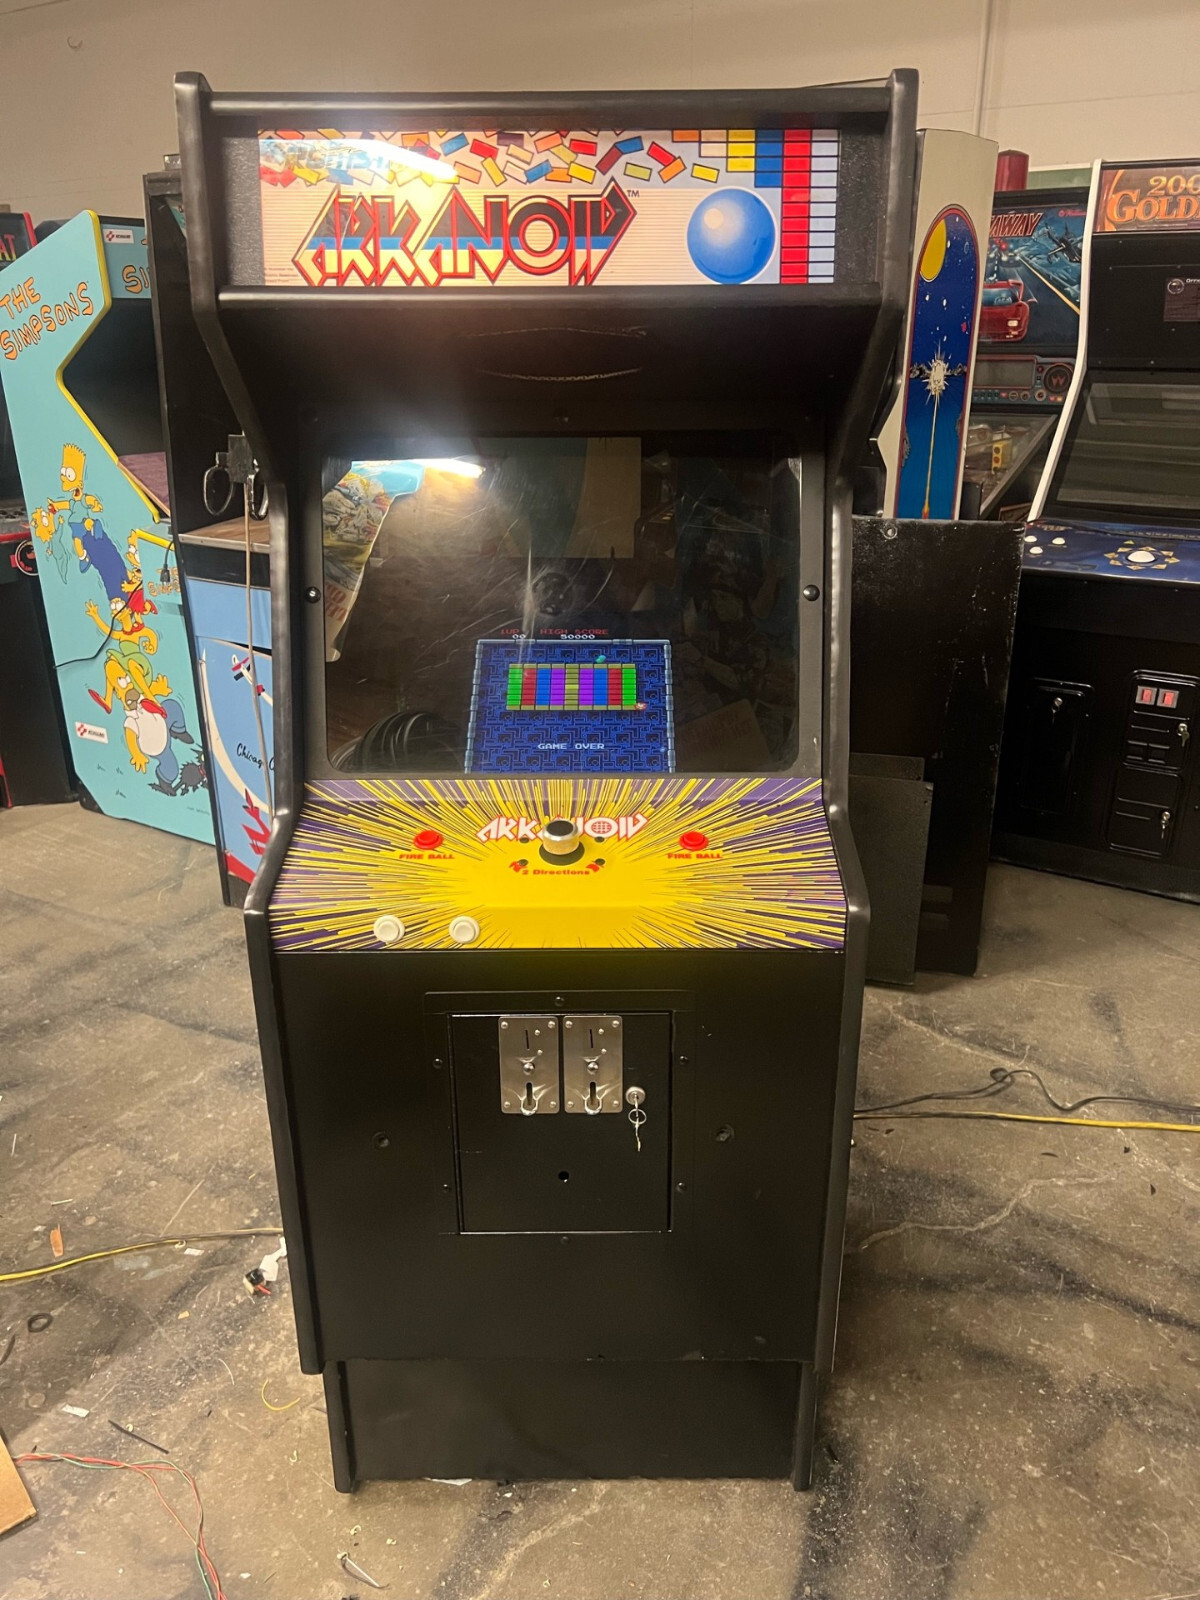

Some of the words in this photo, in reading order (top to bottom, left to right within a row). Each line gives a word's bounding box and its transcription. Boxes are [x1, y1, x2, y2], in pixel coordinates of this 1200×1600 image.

[1106, 188, 1200, 223] GOLD
[292, 176, 637, 287] ARKANOID
[990, 213, 1043, 237] AWAY
[122, 265, 151, 294] SI
[0, 276, 41, 319] THE
[0, 281, 94, 361] SIMPSONS
[236, 743, 266, 769] Chicag
[476, 811, 649, 844] ARKOID
[532, 868, 591, 876] Directions
